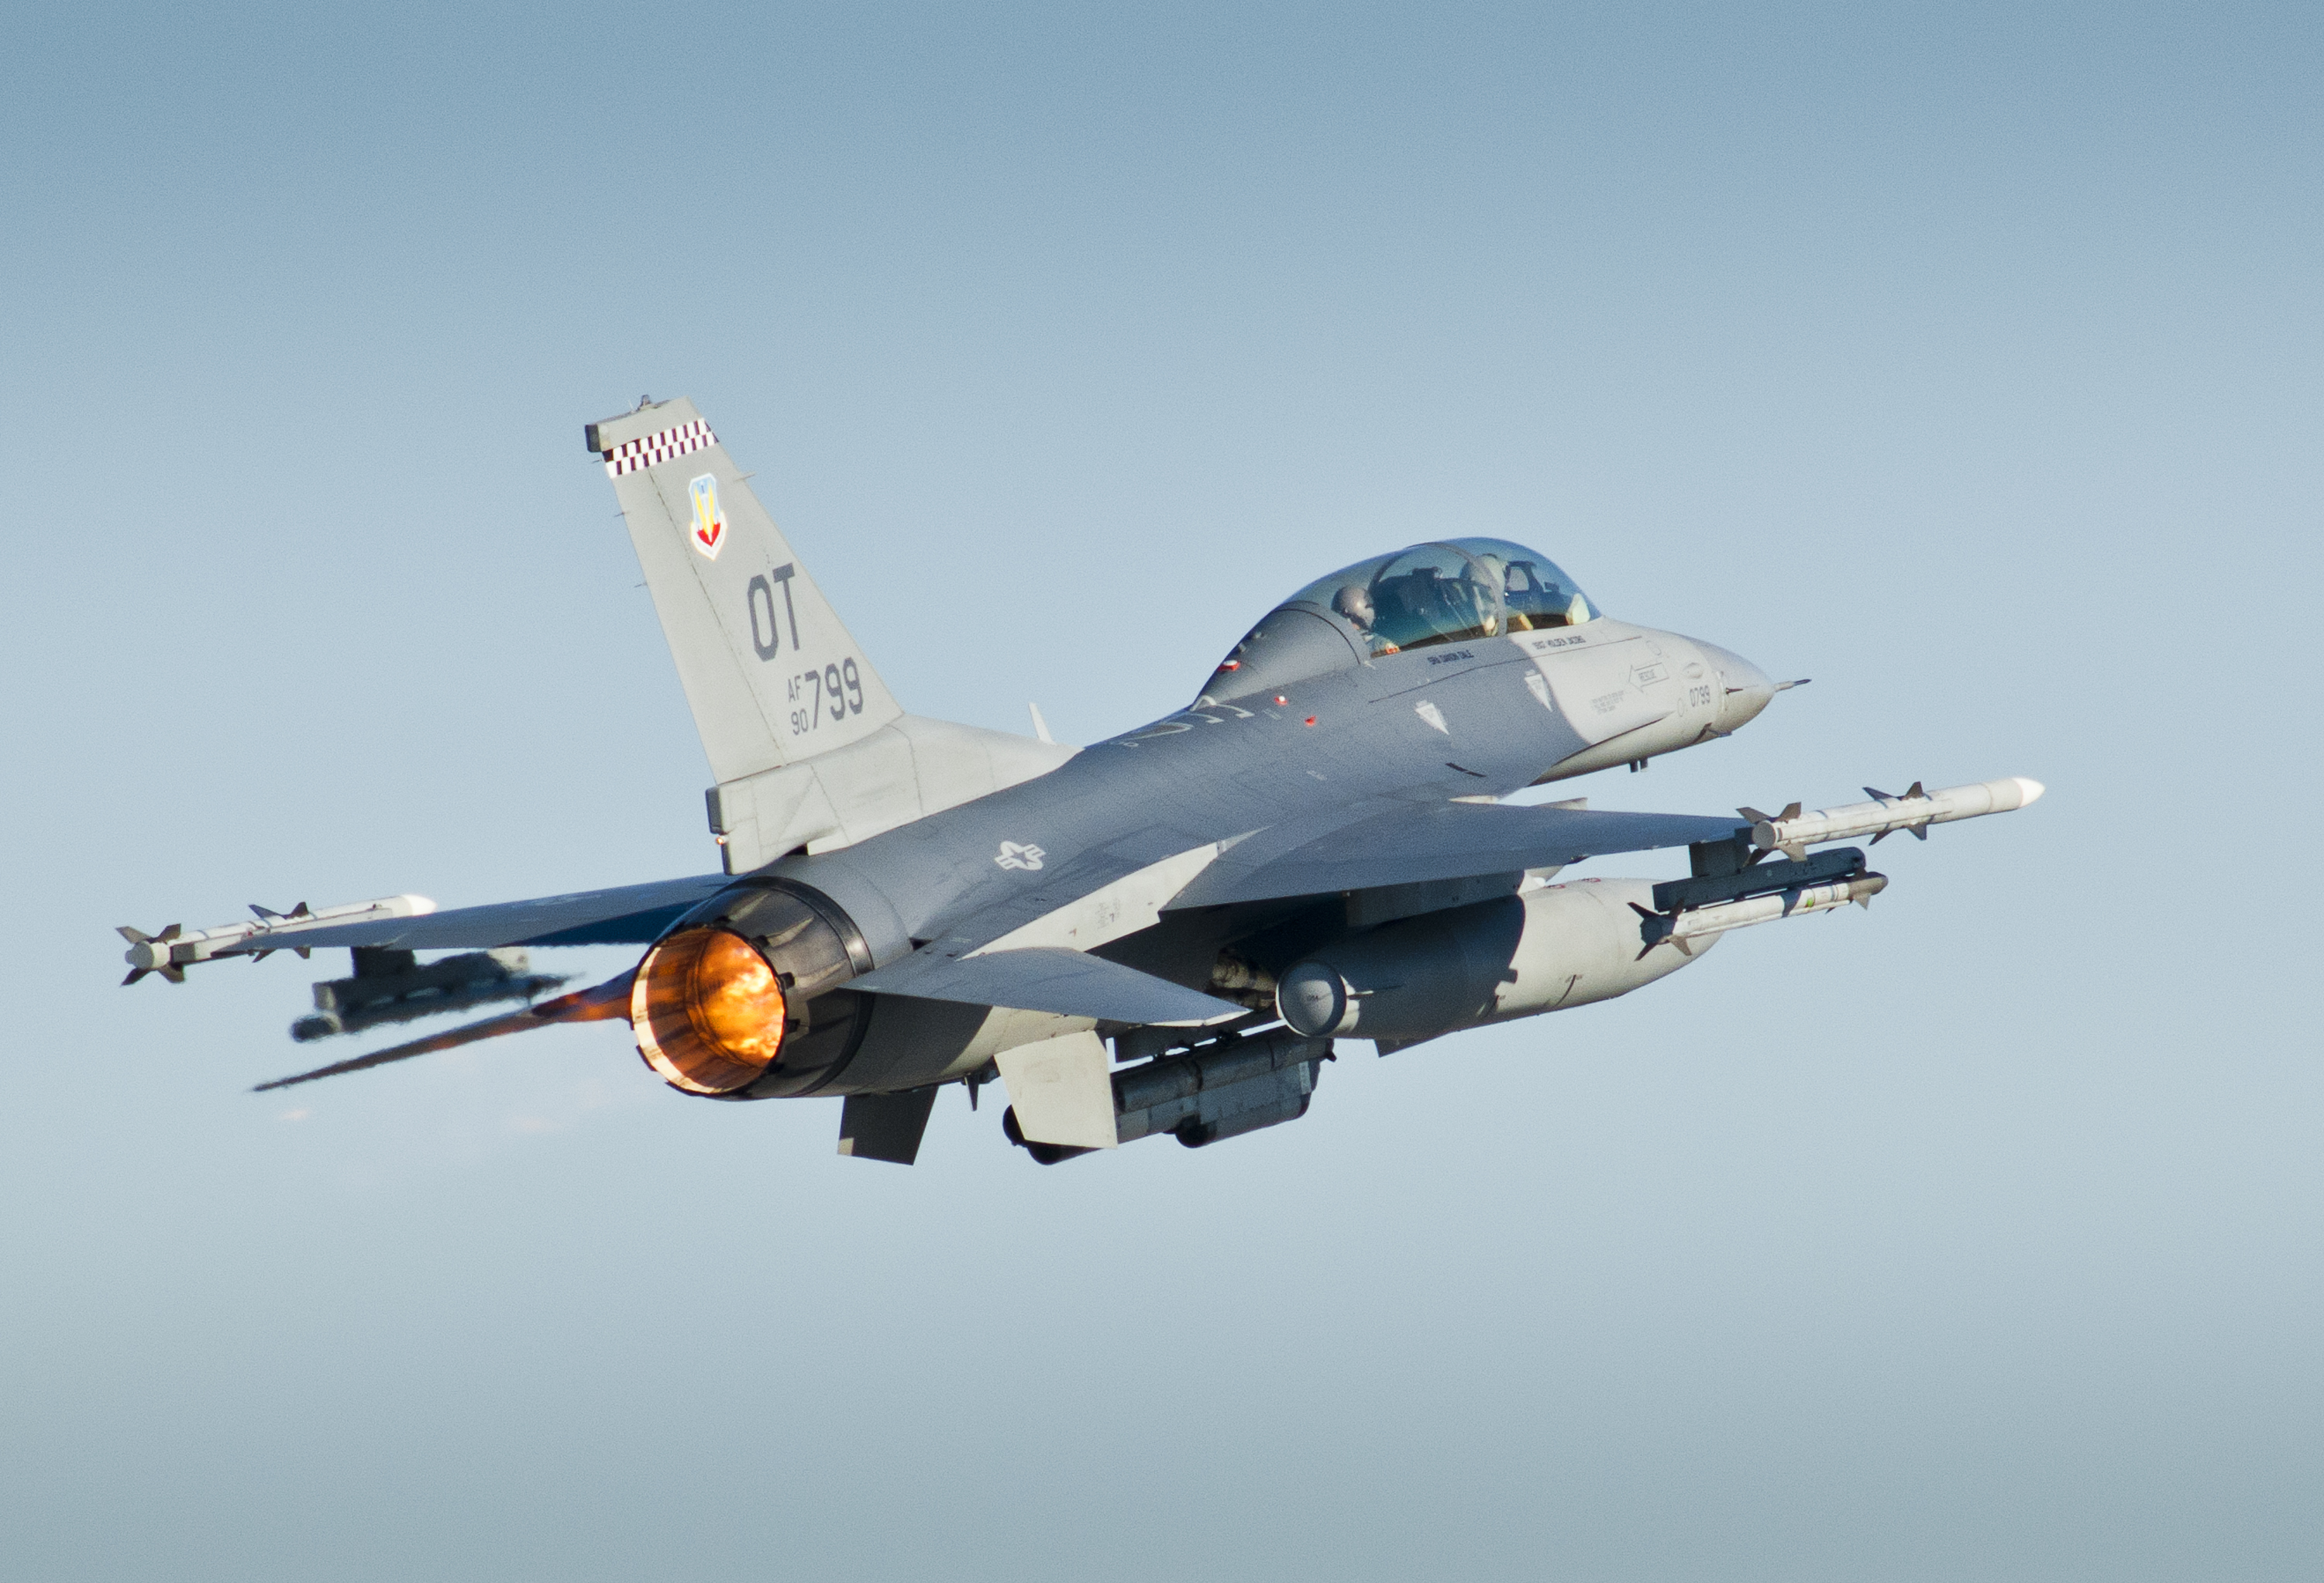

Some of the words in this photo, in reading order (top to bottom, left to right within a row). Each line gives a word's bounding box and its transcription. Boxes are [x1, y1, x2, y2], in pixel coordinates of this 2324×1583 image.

[748, 562, 799, 662] OT
[788, 675, 801, 702] AF
[805, 657, 863, 730] 799
[1690, 685, 1710, 707] 0799
[791, 708, 808, 736] 90
